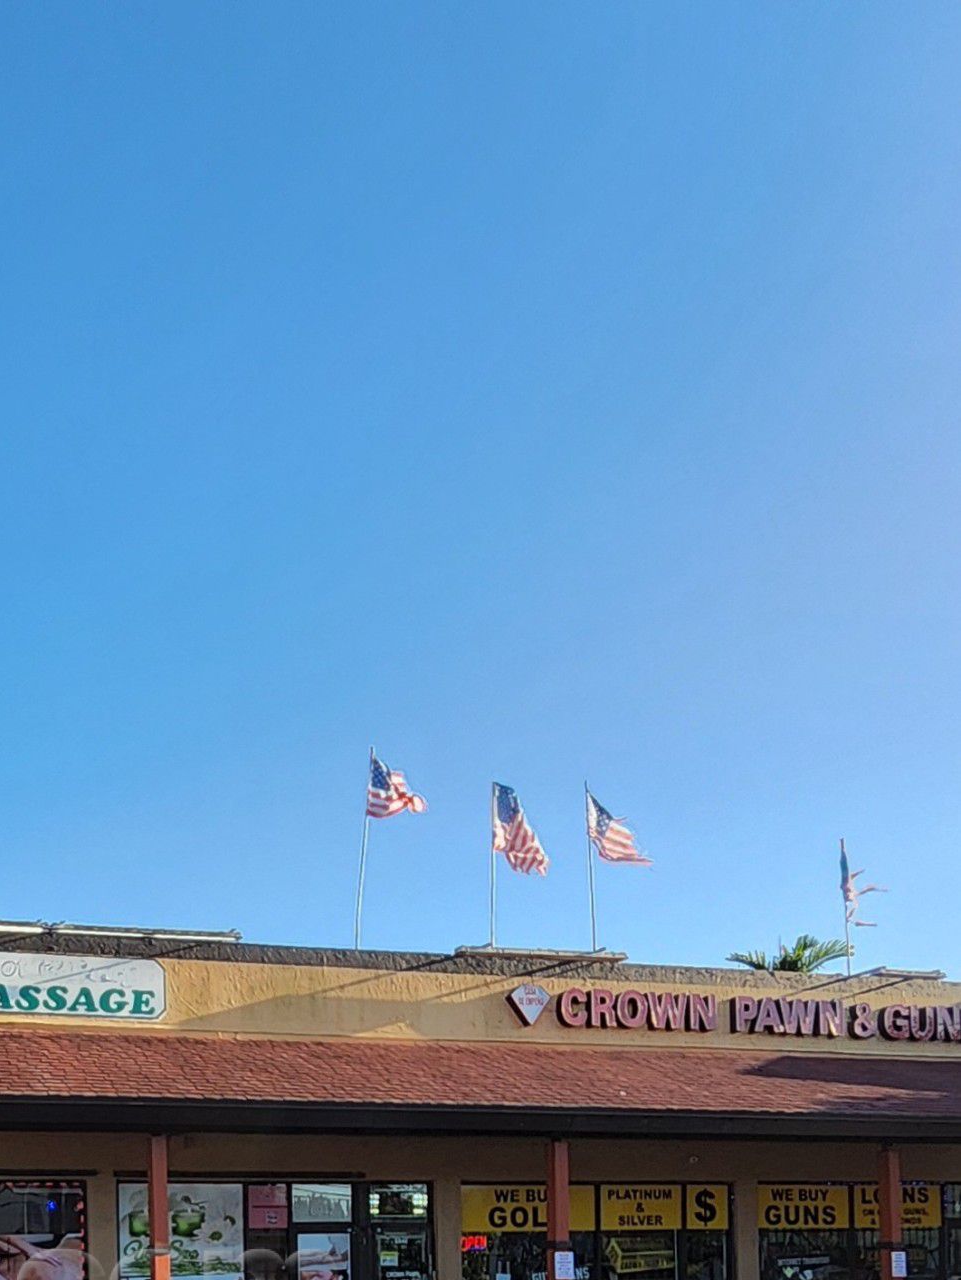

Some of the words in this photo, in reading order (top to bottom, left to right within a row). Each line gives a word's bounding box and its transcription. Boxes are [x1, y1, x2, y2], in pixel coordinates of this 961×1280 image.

[559, 987, 718, 1032] CROWN
[734, 995, 848, 1038] PAWN
[851, 1003, 878, 1039] &
[495, 1189, 519, 1203] WE
[526, 1188, 548, 1203] BU
[608, 1188, 673, 1200] PLATINUM
[771, 1188, 793, 1202] WE
[799, 1188, 829, 1202] BUY
[636, 1203, 645, 1212] &
[694, 1187, 717, 1226] $
[488, 1206, 548, 1228] GOL
[618, 1215, 663, 1226] SILVER
[764, 1205, 836, 1226] GUNS
[460, 1234, 488, 1252] OPEN
